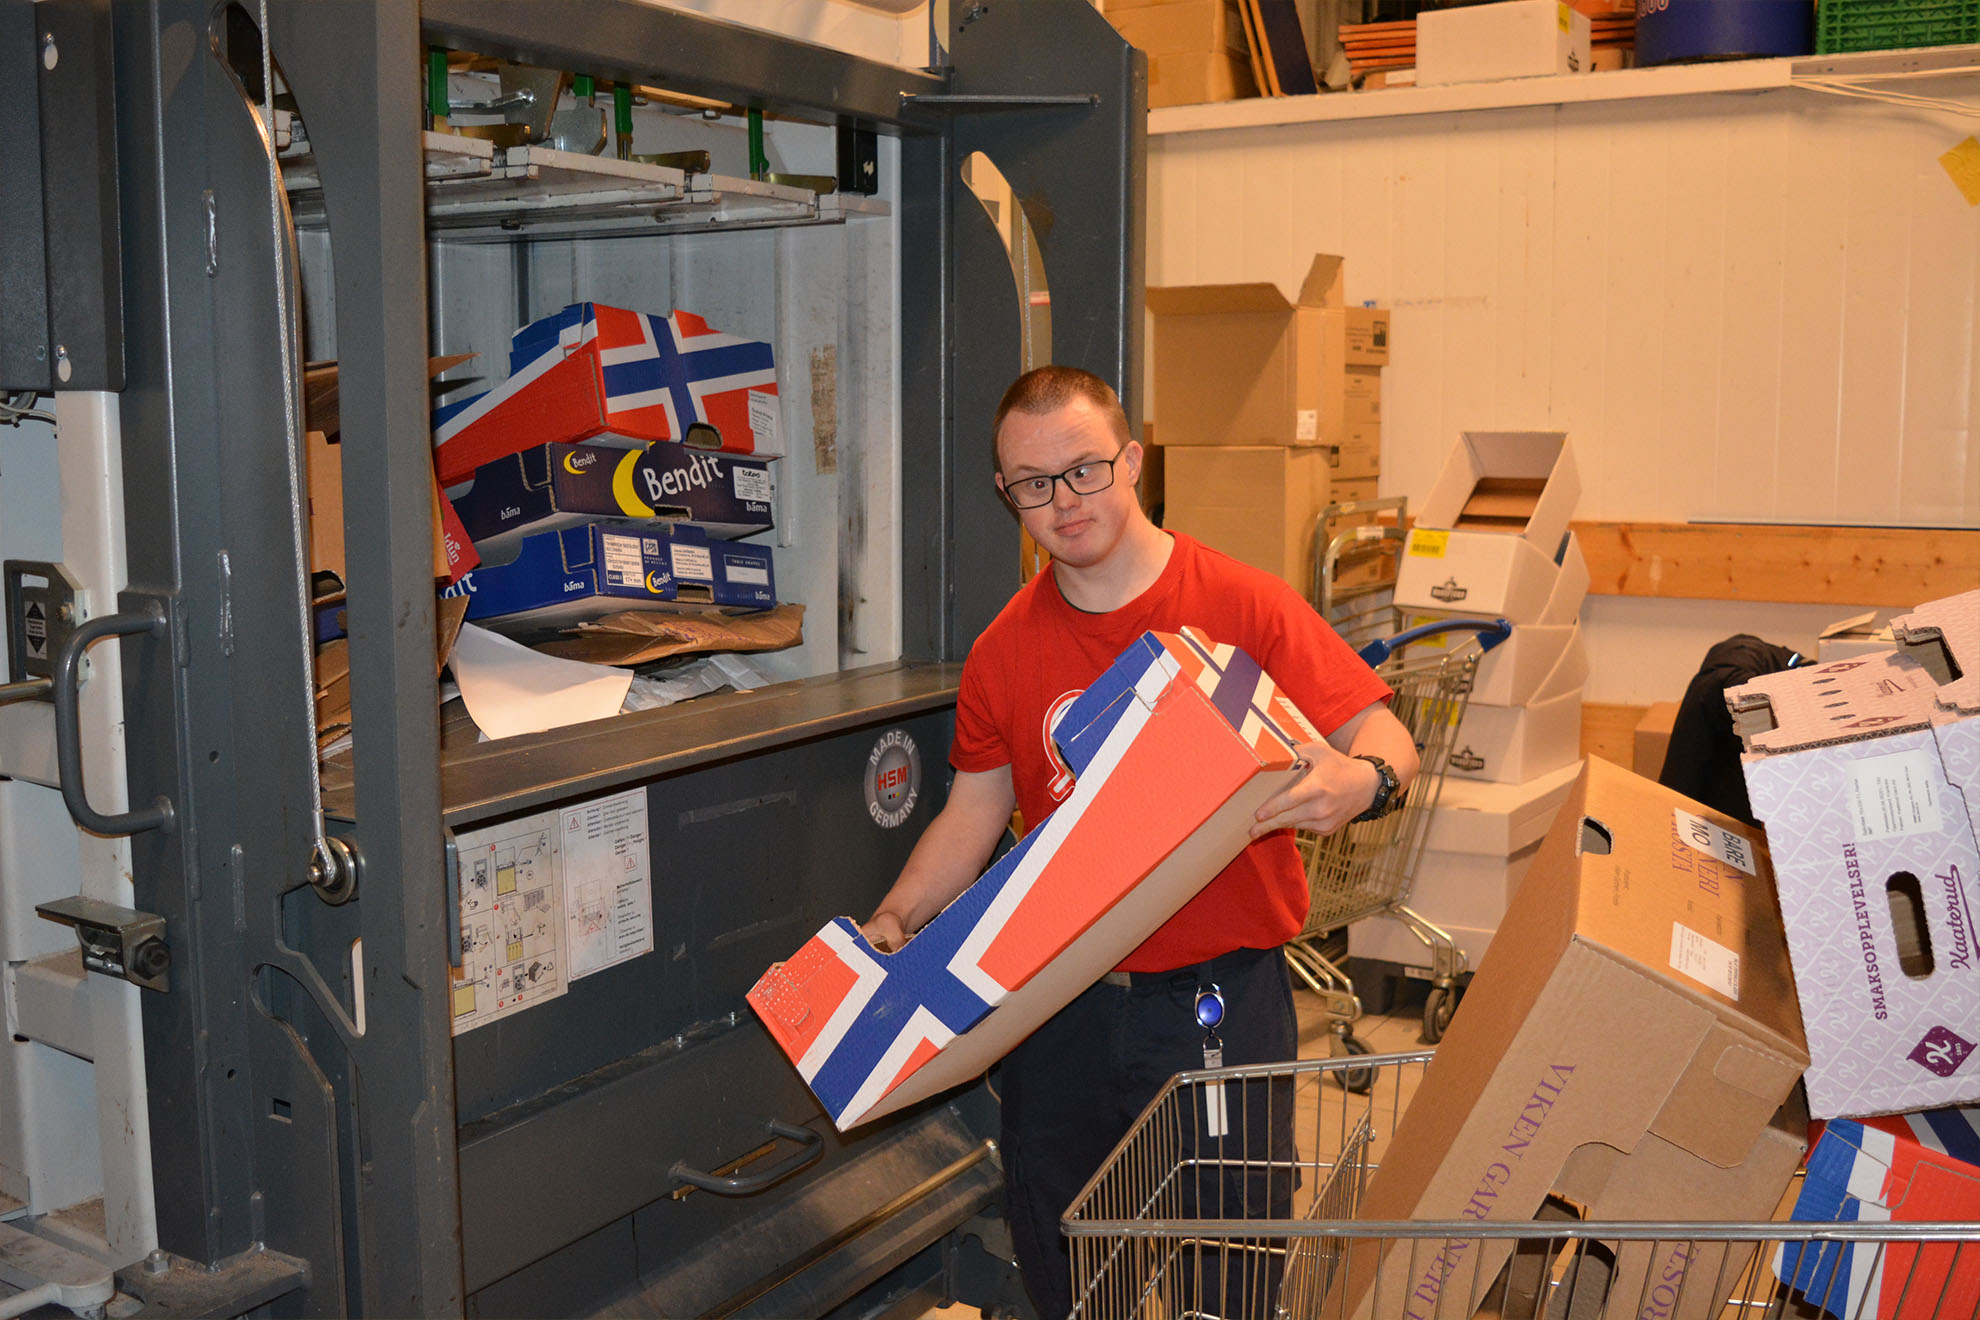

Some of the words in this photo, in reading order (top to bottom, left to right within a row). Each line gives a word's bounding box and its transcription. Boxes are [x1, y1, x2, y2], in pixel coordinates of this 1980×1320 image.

[572, 453, 597, 468] Bendit
[643, 454, 724, 501] Bendit
[870, 730, 902, 766] MADE
[903, 735, 915, 755] IN
[878, 765, 908, 791] HSM
[869, 787, 918, 828] GERMANY
[1721, 831, 1747, 868] BARE
[1842, 842, 1888, 1021] SMAKSOPPLEVELSER!
[1934, 863, 1980, 970] Kaaterud
[1502, 1063, 1577, 1161] VIKEN
